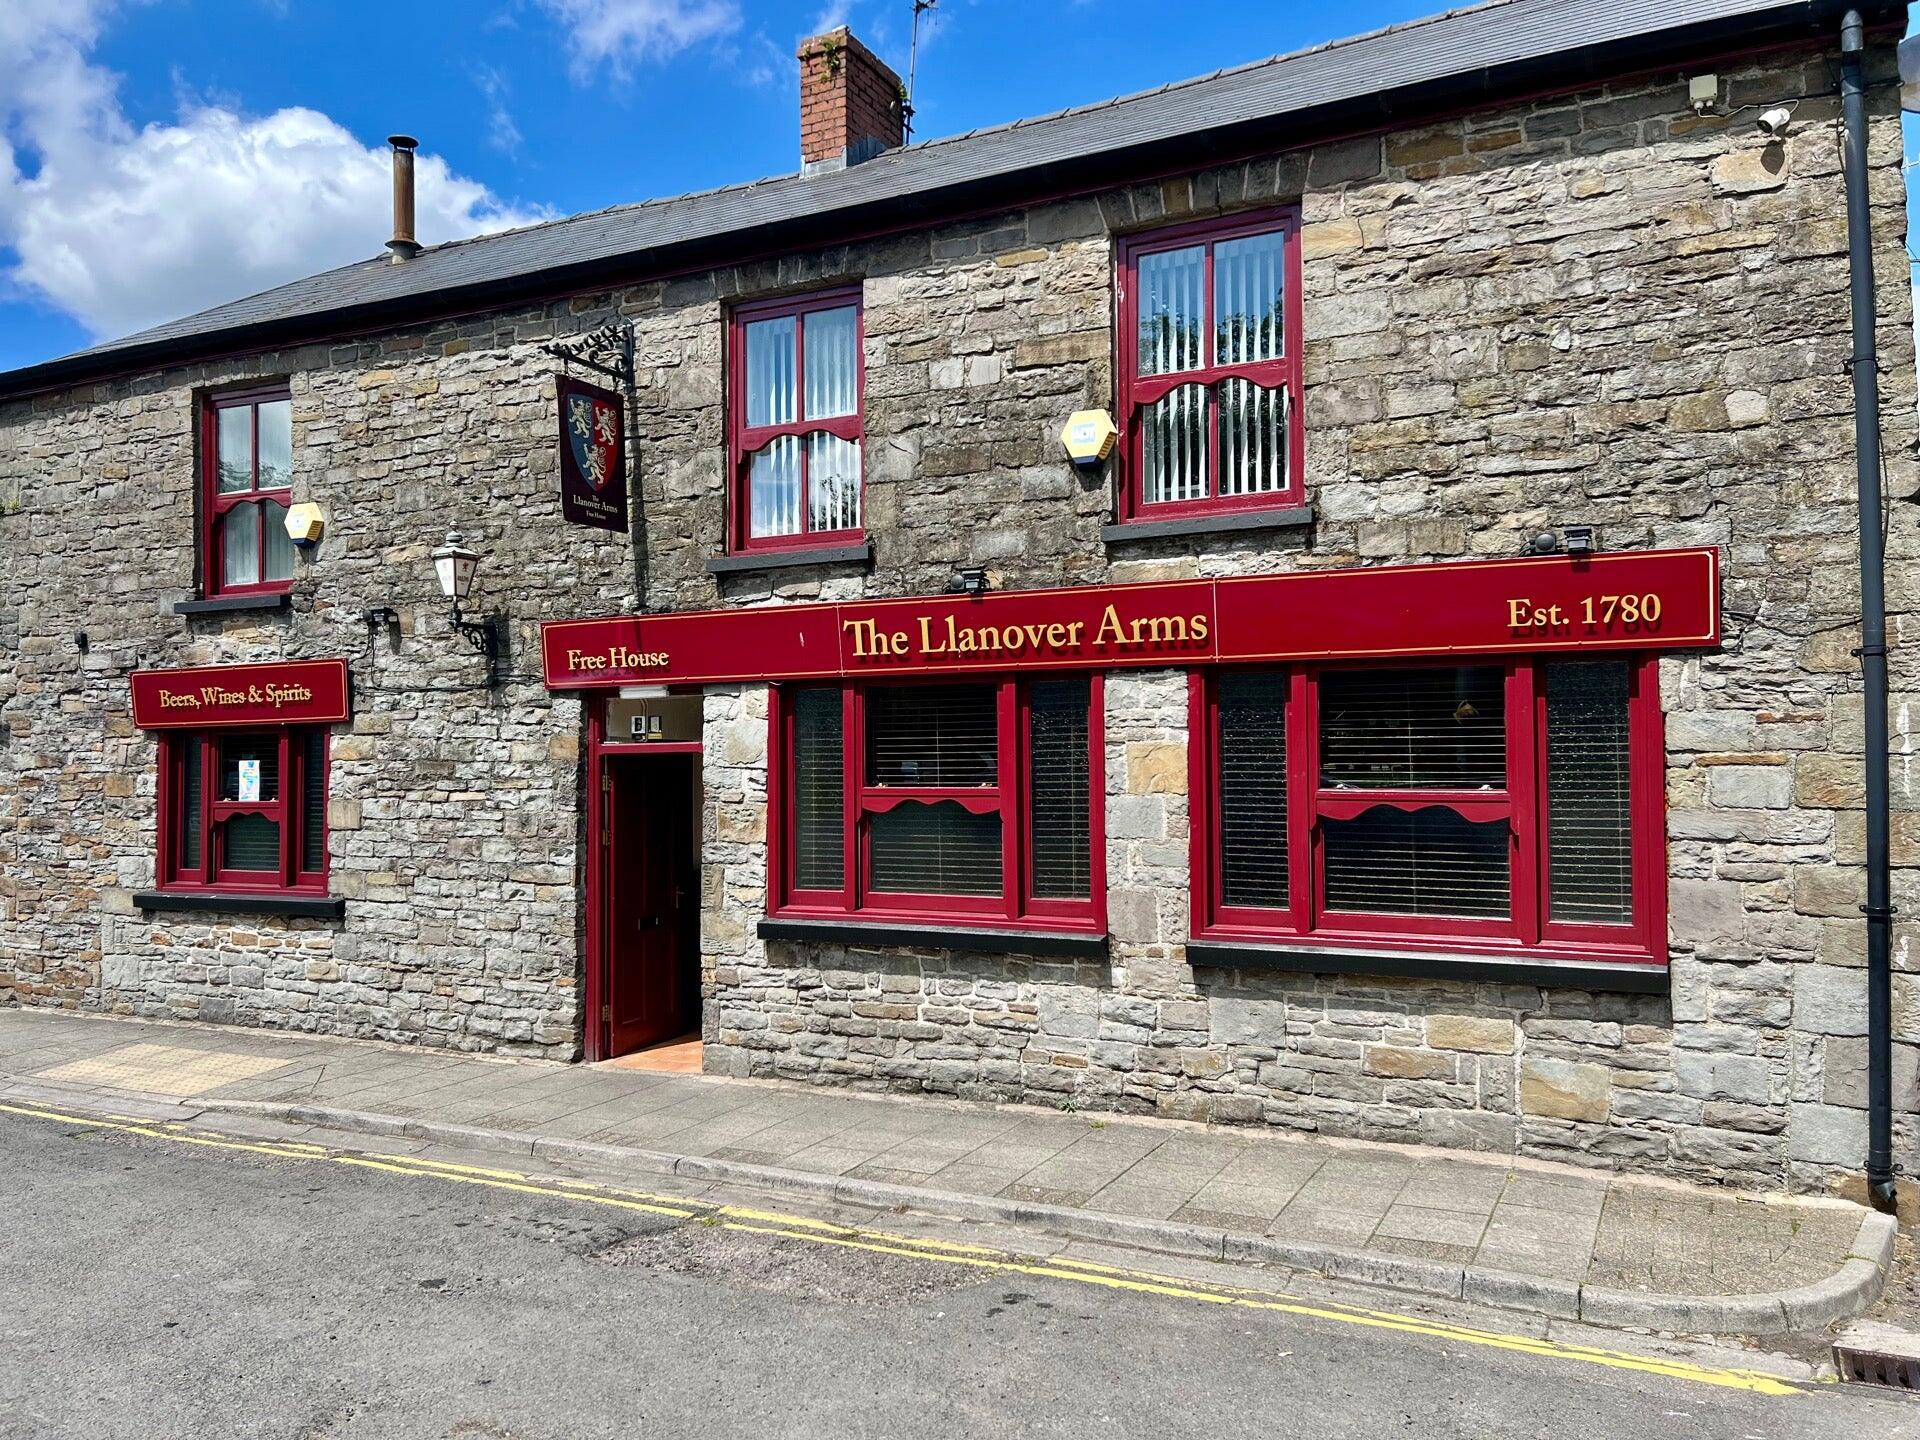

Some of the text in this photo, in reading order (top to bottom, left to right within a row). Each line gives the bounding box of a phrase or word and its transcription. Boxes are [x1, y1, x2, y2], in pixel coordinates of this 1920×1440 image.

[573, 495, 618, 513] Llanover Arms
[1506, 593, 1661, 627] Est. 1780
[843, 603, 1208, 657] The Llanover Arms
[567, 646, 669, 670] Free House
[159, 683, 312, 709] Beers, Wines & Spirits
